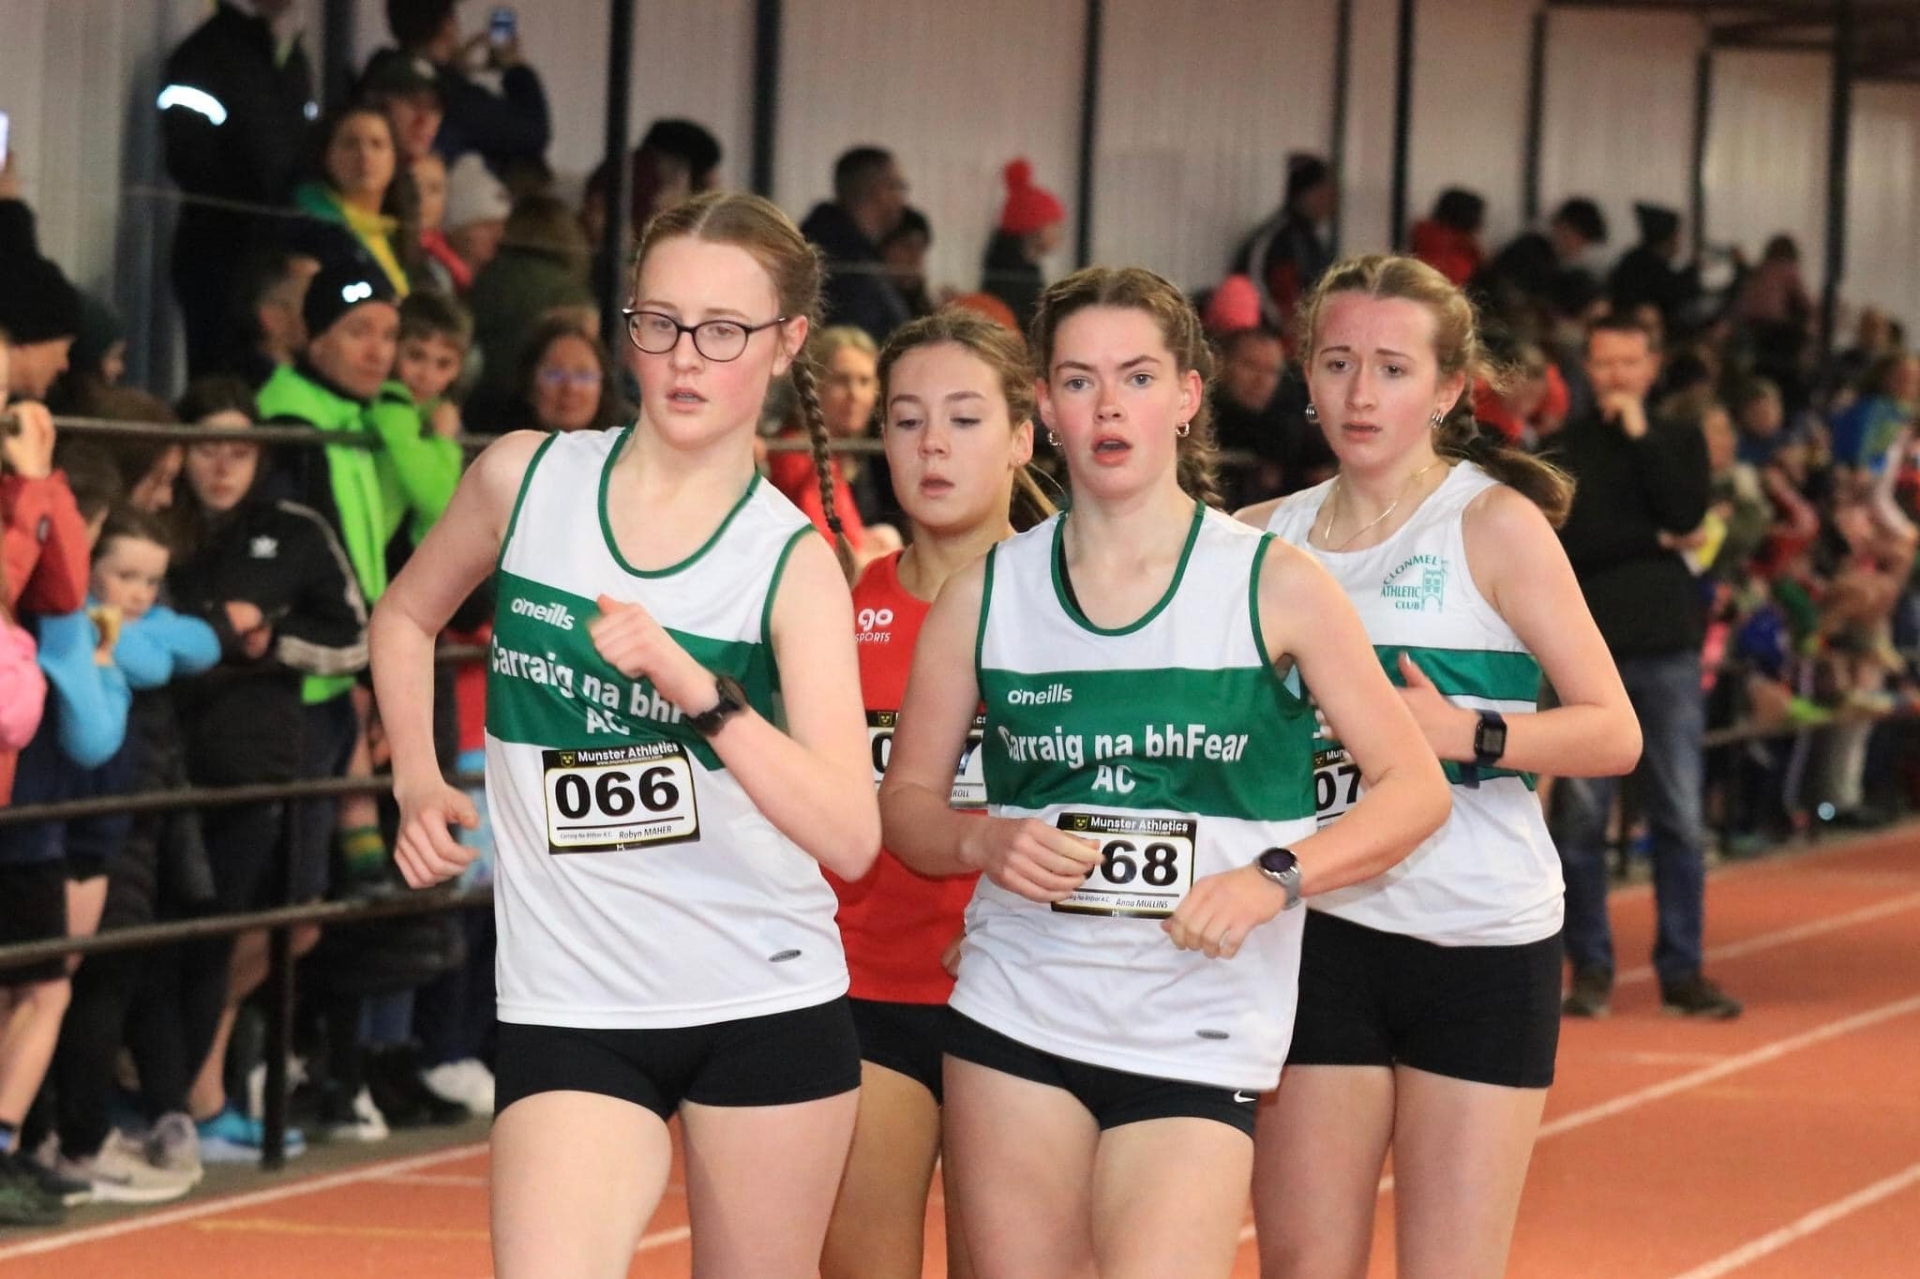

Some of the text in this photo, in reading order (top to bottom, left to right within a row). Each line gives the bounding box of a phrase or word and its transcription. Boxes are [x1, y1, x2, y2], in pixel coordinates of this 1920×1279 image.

[1383, 554, 1438, 585] CLONMEL
[1381, 585, 1421, 598] ATHLETIC
[1395, 601, 1420, 610] CLUB
[858, 608, 894, 631] go
[855, 632, 891, 643] SPORTS
[492, 634, 575, 699] Carraig
[583, 674, 620, 710] na
[578, 750, 626, 763] Munster
[628, 741, 679, 759] Athletics
[1095, 733, 1133, 760] na
[1145, 724, 1249, 763] bhFear
[1091, 764, 1136, 793] AC
[1314, 765, 1362, 811] 07
[555, 766, 679, 819] 066
[952, 789, 969, 798] ROLL
[619, 830, 642, 839] Robyn
[1090, 816, 1138, 829] Munster
[1139, 818, 1189, 832] Athletics
[1085, 839, 1179, 887] 68
[1115, 898, 1168, 909] Anna MULLINS
